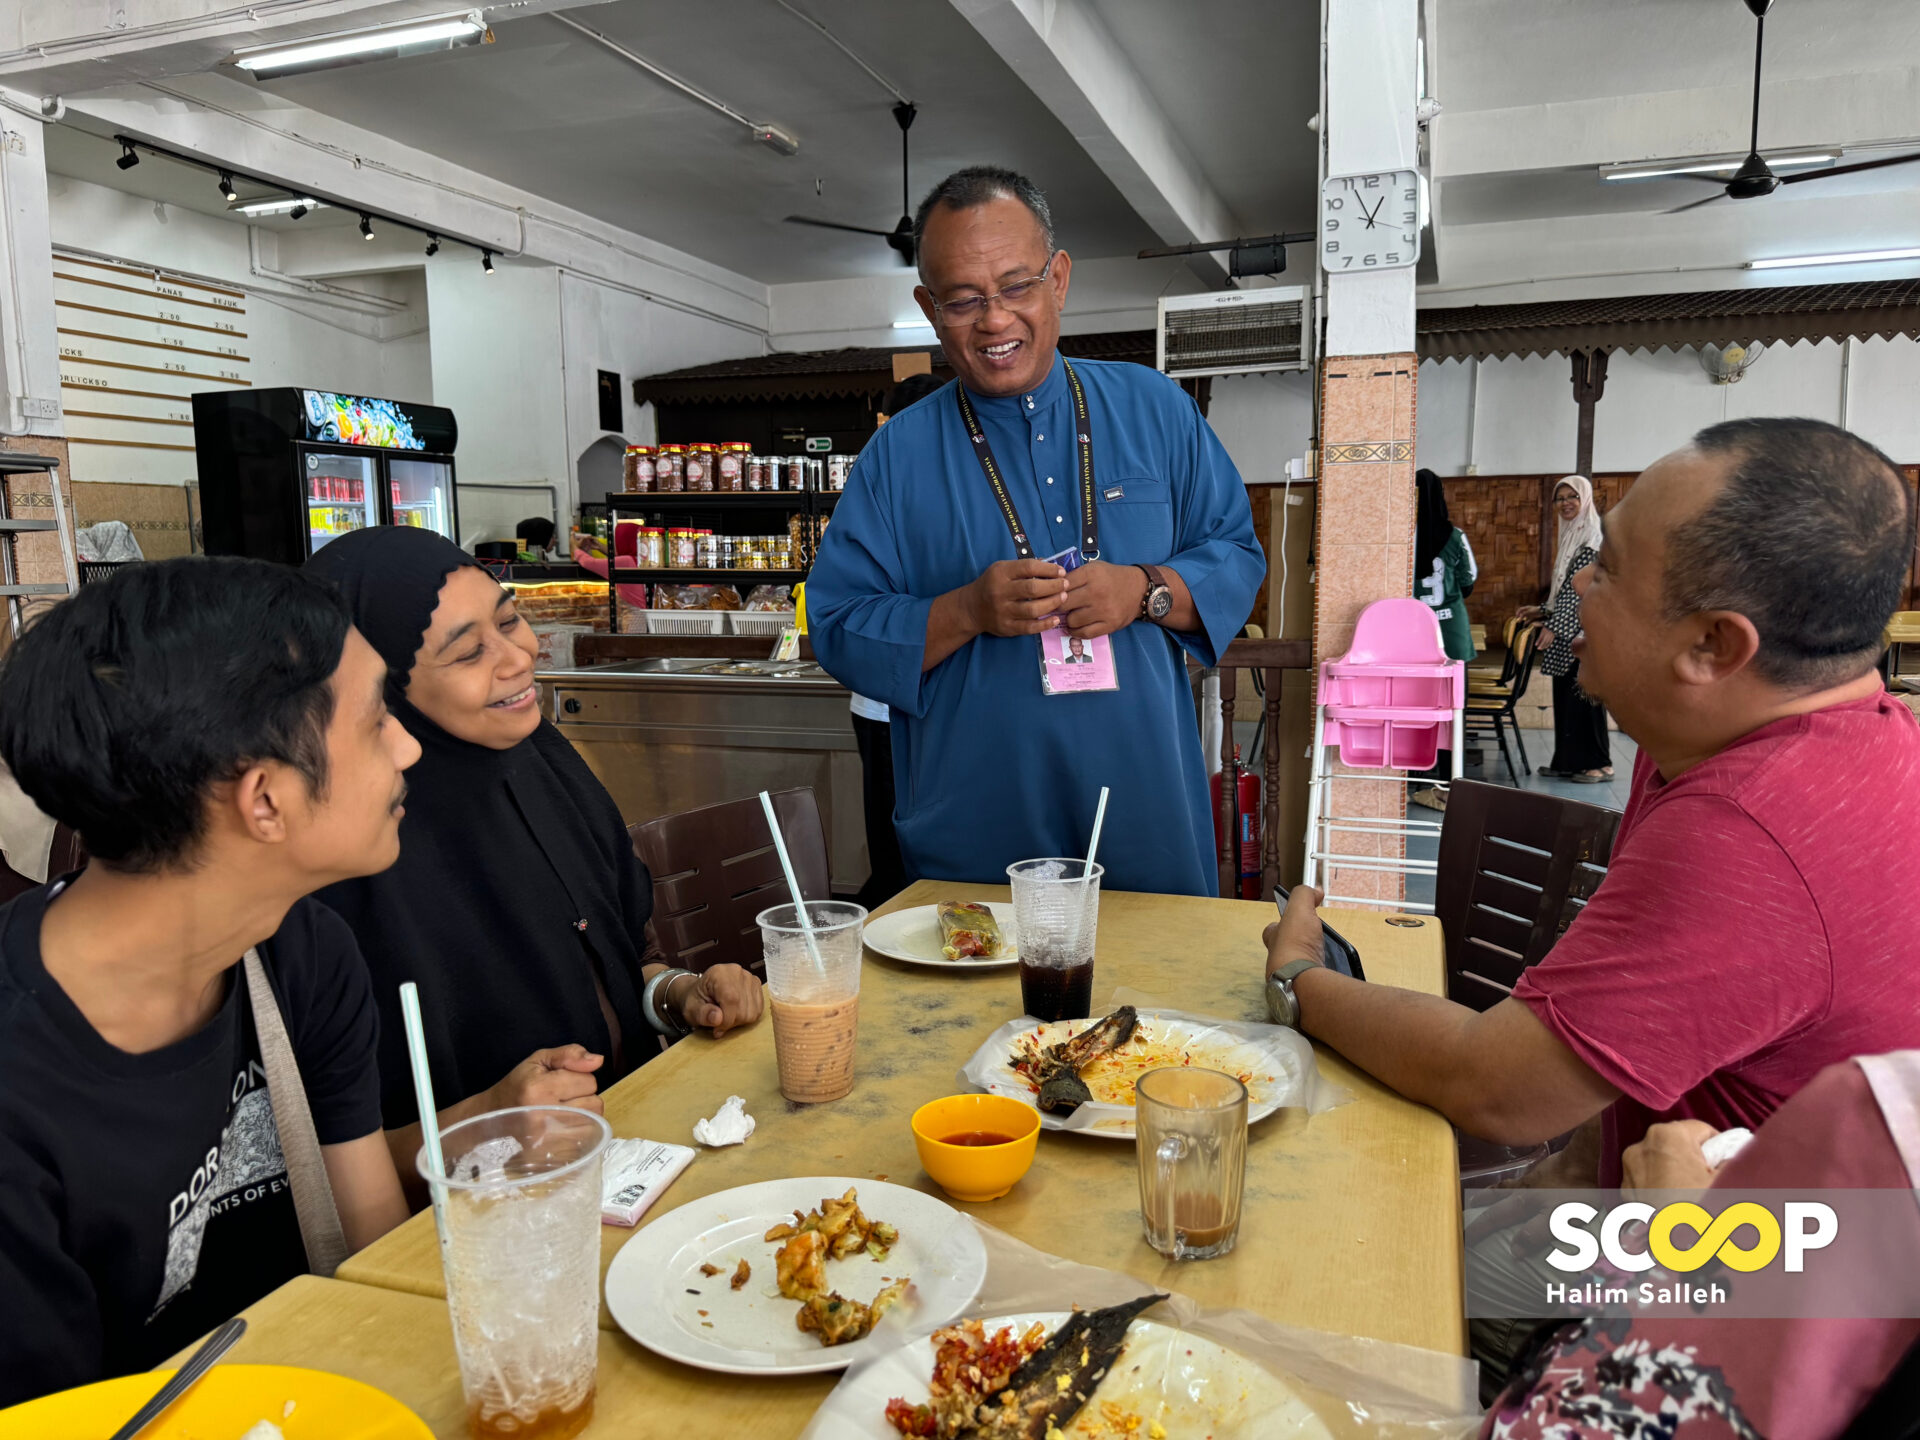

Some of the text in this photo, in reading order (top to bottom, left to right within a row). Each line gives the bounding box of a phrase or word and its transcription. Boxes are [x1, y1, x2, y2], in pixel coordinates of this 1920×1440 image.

[1341, 173, 1397, 191] 11 12 1
[1403, 188, 1417, 201] 2
[1325, 197, 1344, 211] 10
[1402, 211, 1416, 224] 3
[1325, 218, 1340, 232] 9
[1325, 240, 1340, 253] 8
[1402, 233, 1416, 247] 4
[1341, 252, 1400, 269] 7 6 5
[156, 286, 237, 308] PANAS SEJUK
[244, 1186, 267, 1201] OF
